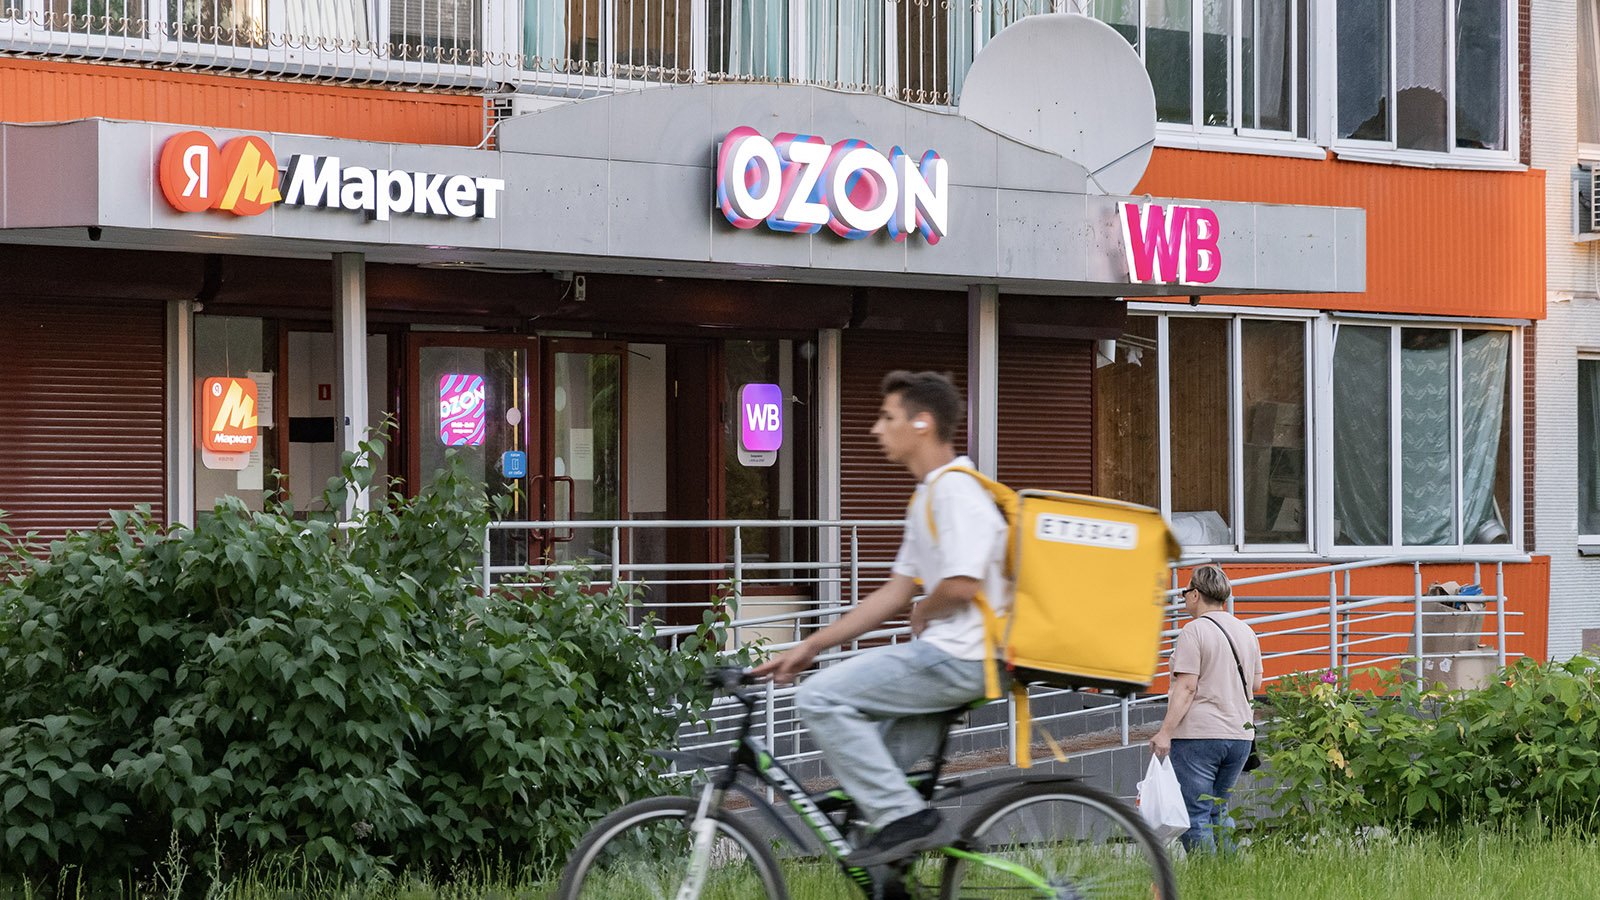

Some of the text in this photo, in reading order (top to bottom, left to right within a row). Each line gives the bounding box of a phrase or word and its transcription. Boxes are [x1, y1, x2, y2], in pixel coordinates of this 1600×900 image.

[182, 145, 209, 198] Я
[282, 154, 505, 221] Маркет
[723, 131, 948, 241] OZON
[1119, 201, 1222, 285] WB
[441, 385, 484, 418] OZON
[745, 403, 780, 432] WB
[213, 433, 253, 445] Маркет
